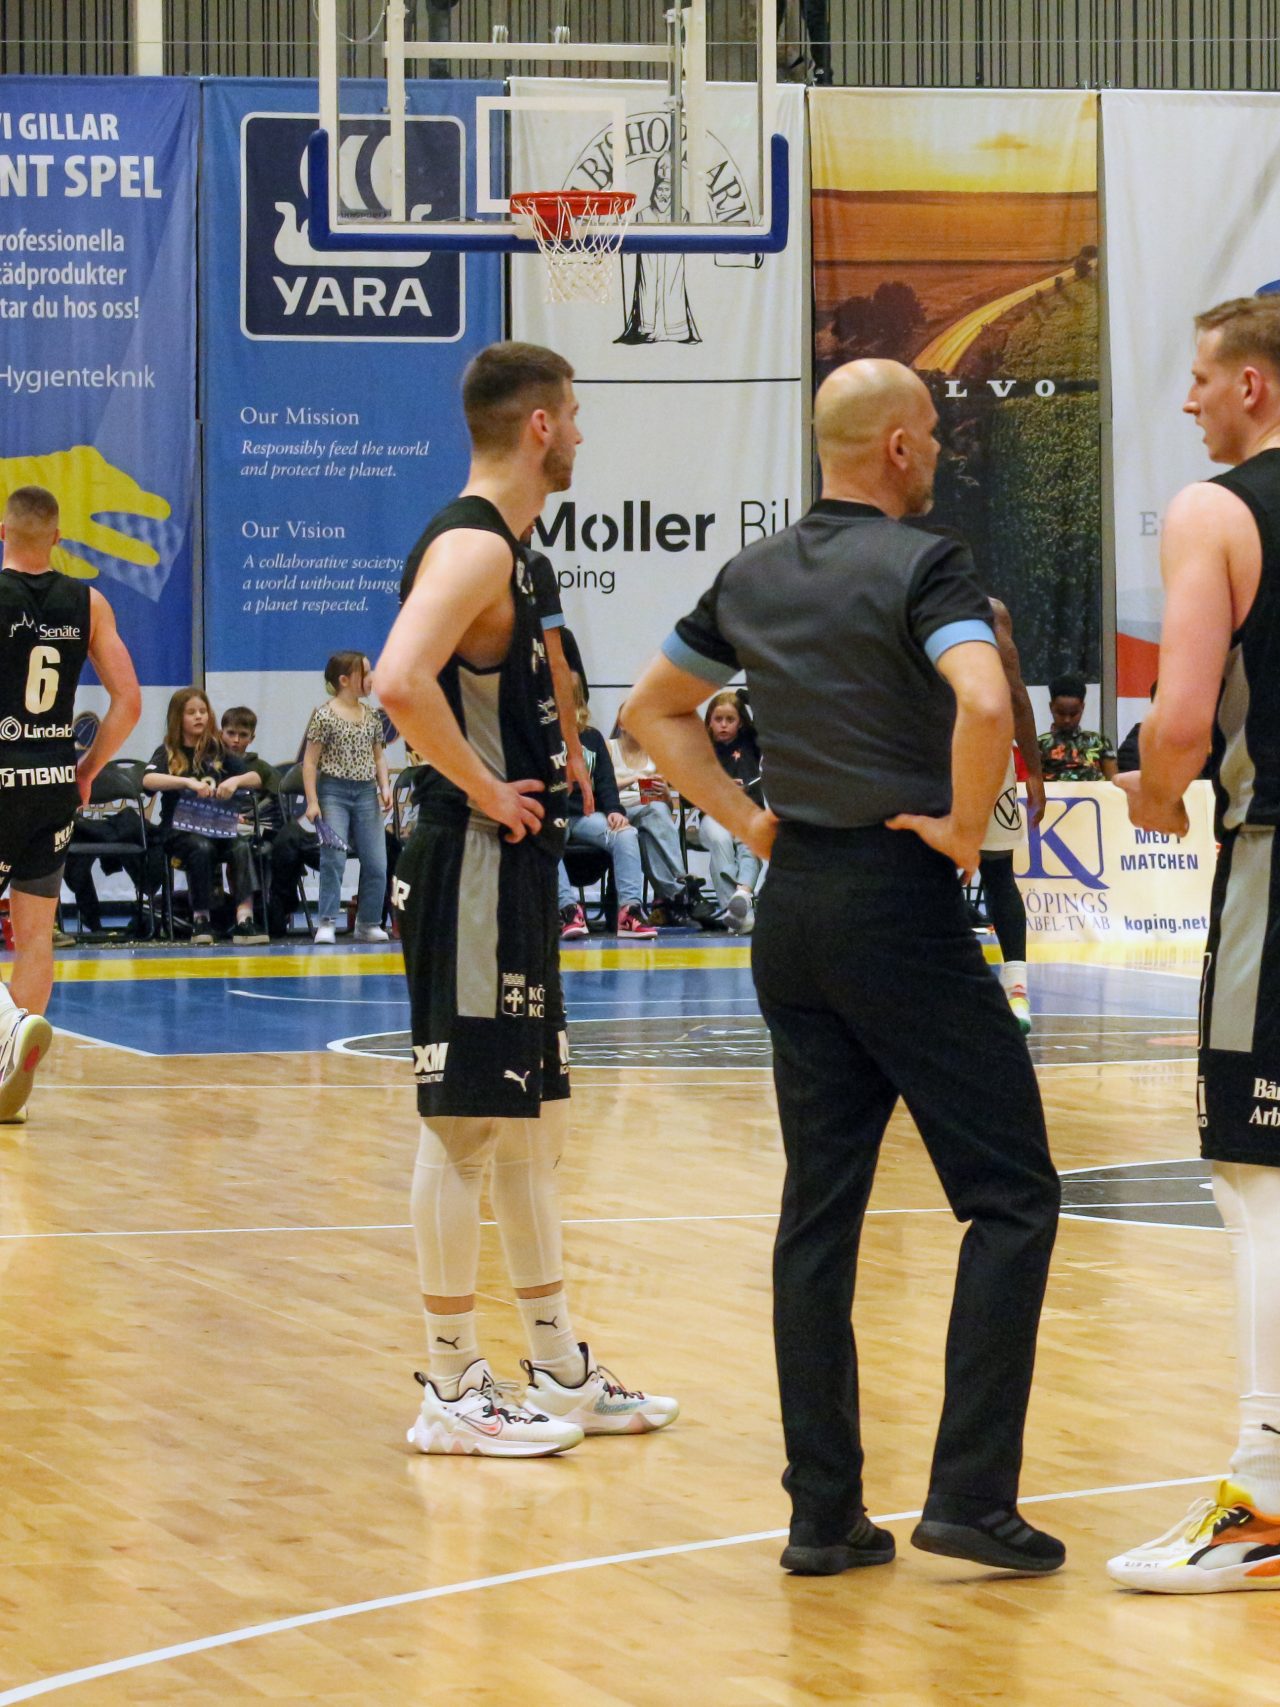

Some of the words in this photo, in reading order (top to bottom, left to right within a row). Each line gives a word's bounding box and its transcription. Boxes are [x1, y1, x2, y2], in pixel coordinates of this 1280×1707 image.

[0, 113, 12, 140] I
[19, 113, 119, 141] GILLAR
[64, 155, 162, 199] SPEL
[272, 277, 433, 317] YARA
[32, 295, 58, 319] du
[64, 295, 97, 319] hos
[102, 296, 139, 319] oss!
[945, 379, 1056, 398] LVO
[240, 406, 279, 425] Our
[285, 406, 360, 425] Mission
[242, 440, 326, 458] Responsibly
[329, 440, 359, 458] feed
[361, 440, 385, 456] the
[387, 440, 430, 456] world
[240, 461, 268, 477] and
[271, 463, 321, 480] protect
[324, 461, 346, 477] the
[349, 462, 397, 480] planet.
[242, 521, 280, 539] Our
[286, 520, 346, 539] Vision
[243, 554, 255, 569] A
[259, 553, 349, 569] collaborative
[242, 580, 252, 591] a
[255, 574, 297, 591] world
[301, 574, 355, 591] without
[358, 575, 401, 594] hunge
[557, 565, 616, 595] ping
[242, 600, 252, 612] a
[255, 597, 299, 615] planet
[302, 597, 369, 615] respected.
[39, 623, 81, 638] Senäte
[25, 645, 61, 715] 6
[24, 722, 73, 739] Lindab
[1120, 853, 1199, 871] MATCHEN
[1022, 888, 1109, 914] ÖPINGS
[1026, 915, 1087, 931] ABEL-TV
[1092, 916, 1111, 931] AB
[1124, 913, 1208, 934] koping.net
